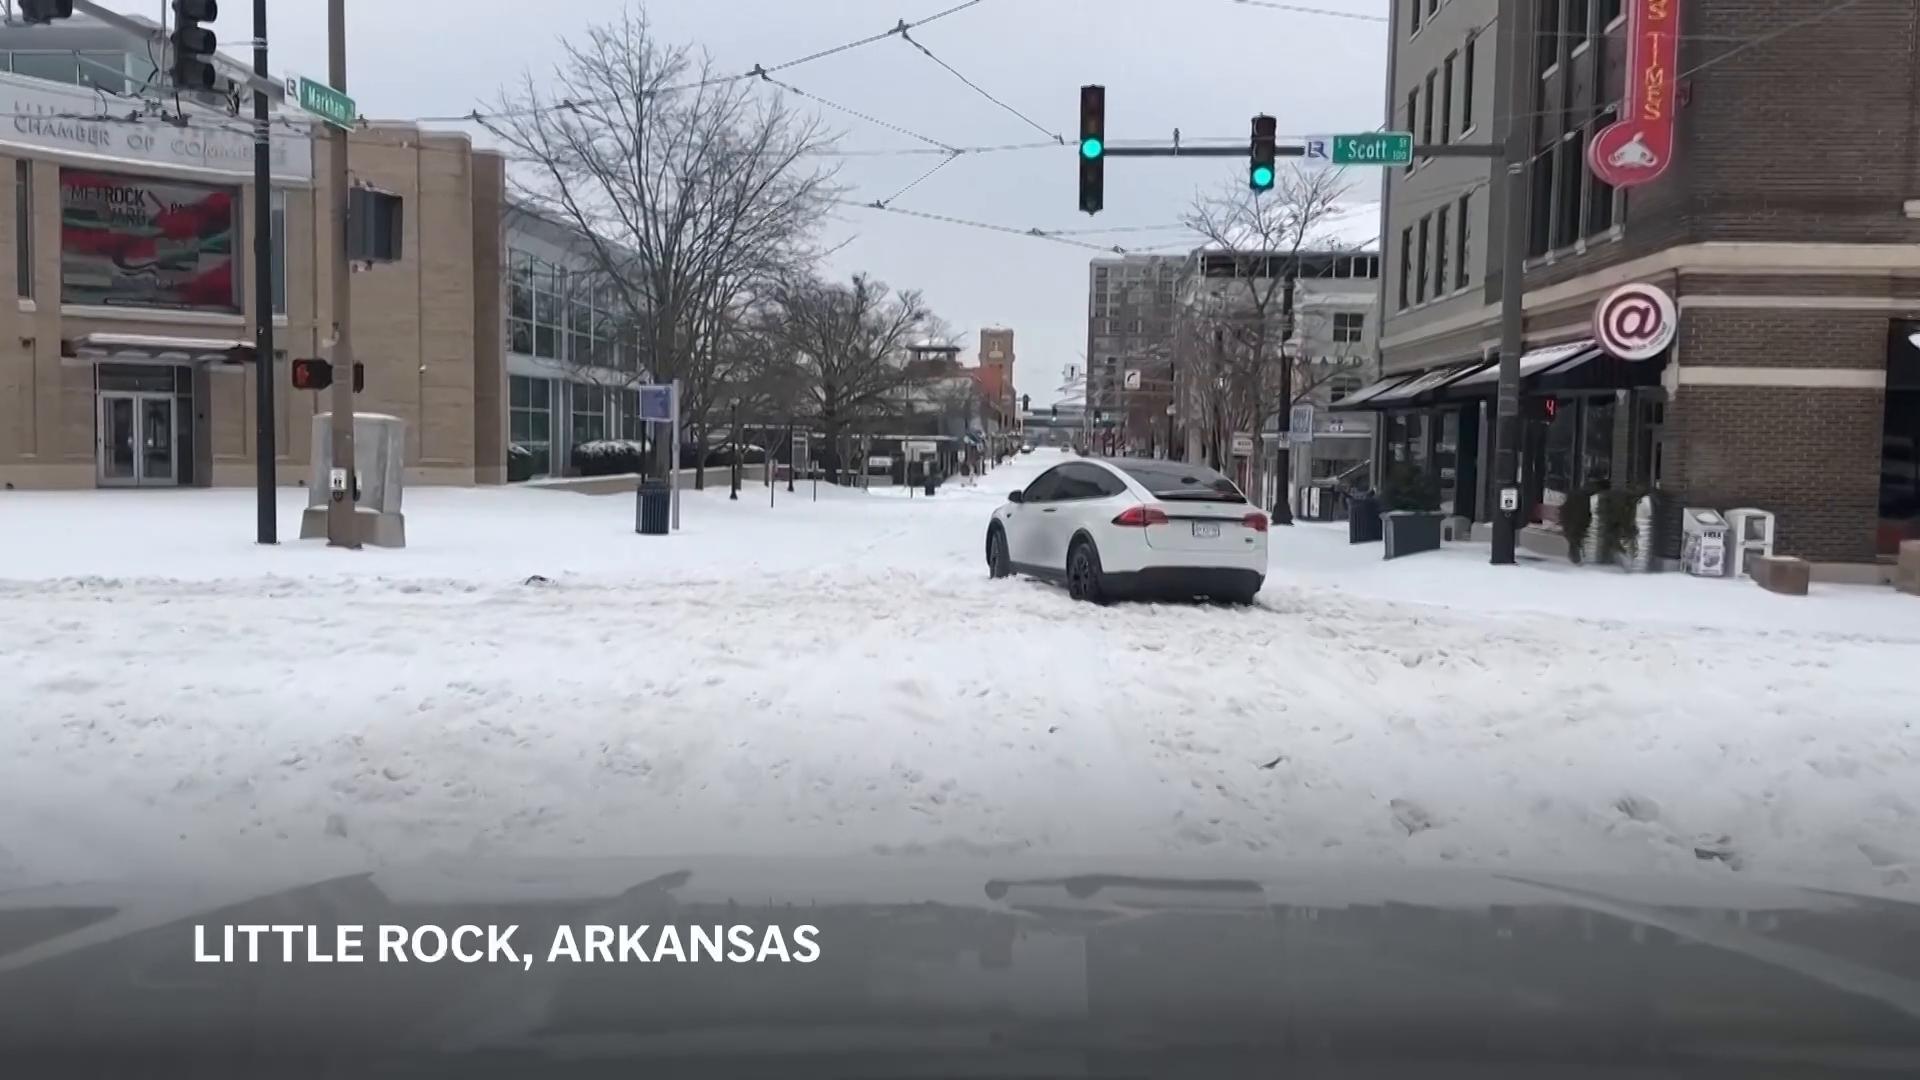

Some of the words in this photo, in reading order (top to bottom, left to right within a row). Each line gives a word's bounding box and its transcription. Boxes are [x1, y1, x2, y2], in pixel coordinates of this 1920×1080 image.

[1643, 31, 1665, 120] TIMES
[308, 84, 346, 121] Markham
[13, 115, 111, 148] CHAMBER
[1348, 139, 1388, 160] Scott
